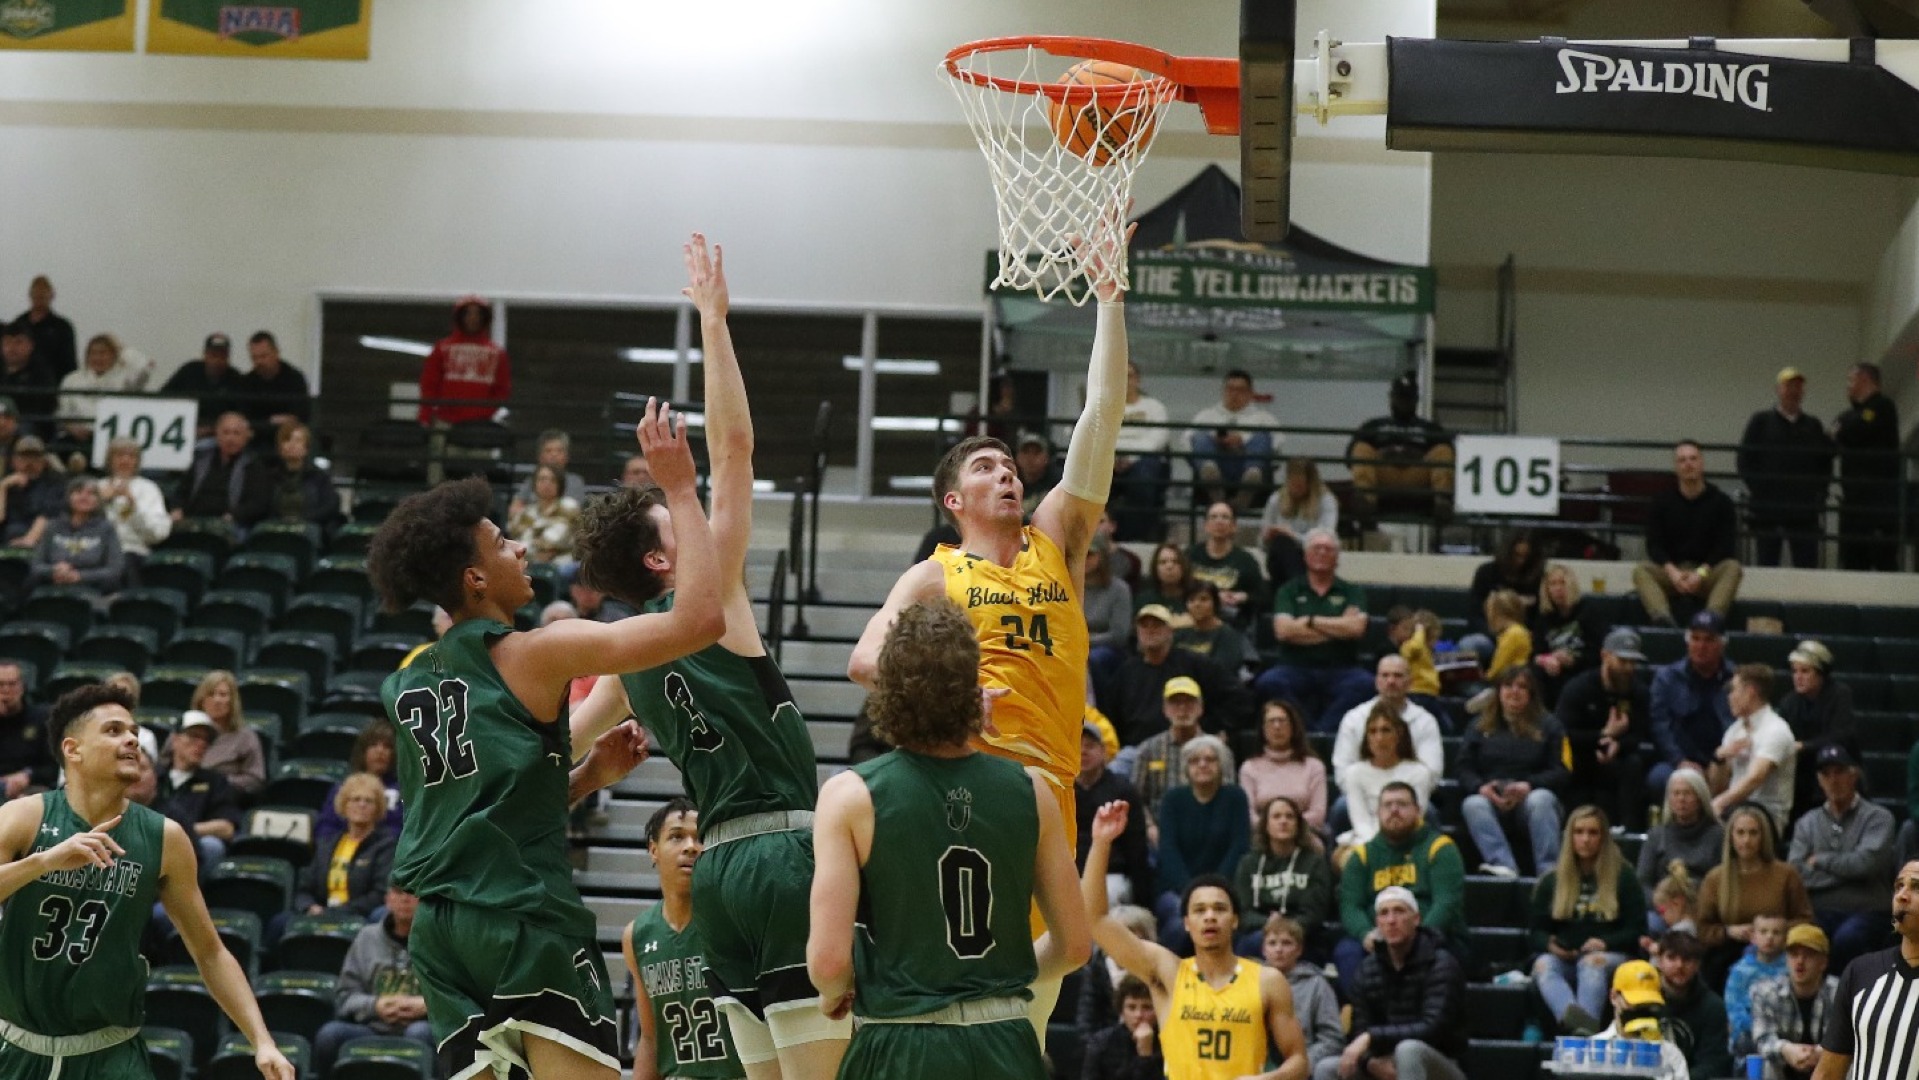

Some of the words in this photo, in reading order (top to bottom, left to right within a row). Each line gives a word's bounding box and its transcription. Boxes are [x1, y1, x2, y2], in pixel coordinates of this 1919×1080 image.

[224, 9, 296, 34] NAIA
[1556, 48, 1770, 112] SPALDING
[1134, 264, 1182, 296] THE
[1191, 265, 1418, 304] YELLOWJACKETS
[100, 413, 186, 452] 104
[1463, 455, 1552, 497] 105
[1000, 614, 1053, 656] 24
[394, 678, 479, 788] 32
[664, 671, 724, 753] 3
[937, 845, 997, 959] 0
[31, 894, 110, 965] 33
[662, 997, 727, 1064] 22
[1197, 1028, 1232, 1060] 20
